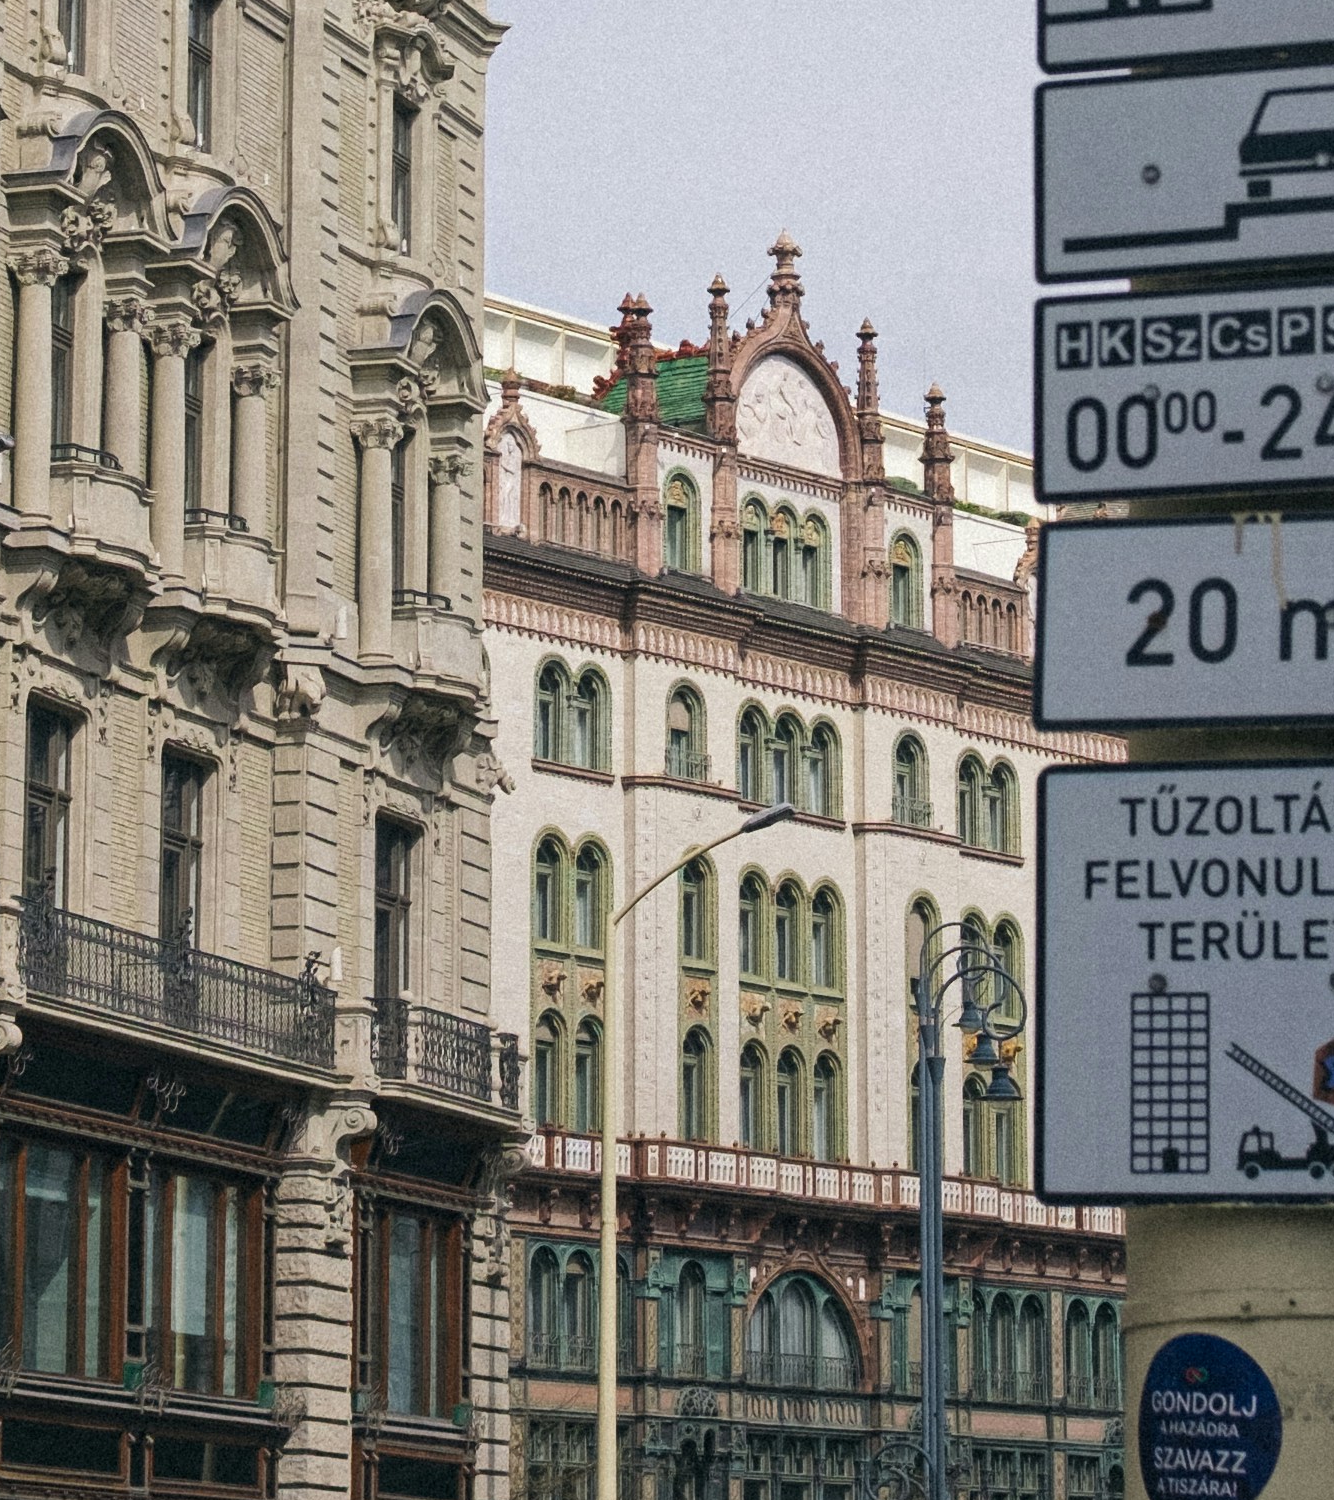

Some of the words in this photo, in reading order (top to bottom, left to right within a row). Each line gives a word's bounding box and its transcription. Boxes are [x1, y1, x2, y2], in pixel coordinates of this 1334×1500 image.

[1126, 577, 1238, 667] 20
[1151, 1390, 1257, 1418] GONDOLJ
[1169, 1418, 1240, 1438] HAZÁDRA
[1154, 1446, 1247, 1474] SZAVAZZ
[1167, 1474, 1238, 1498] TISZÁRA!
